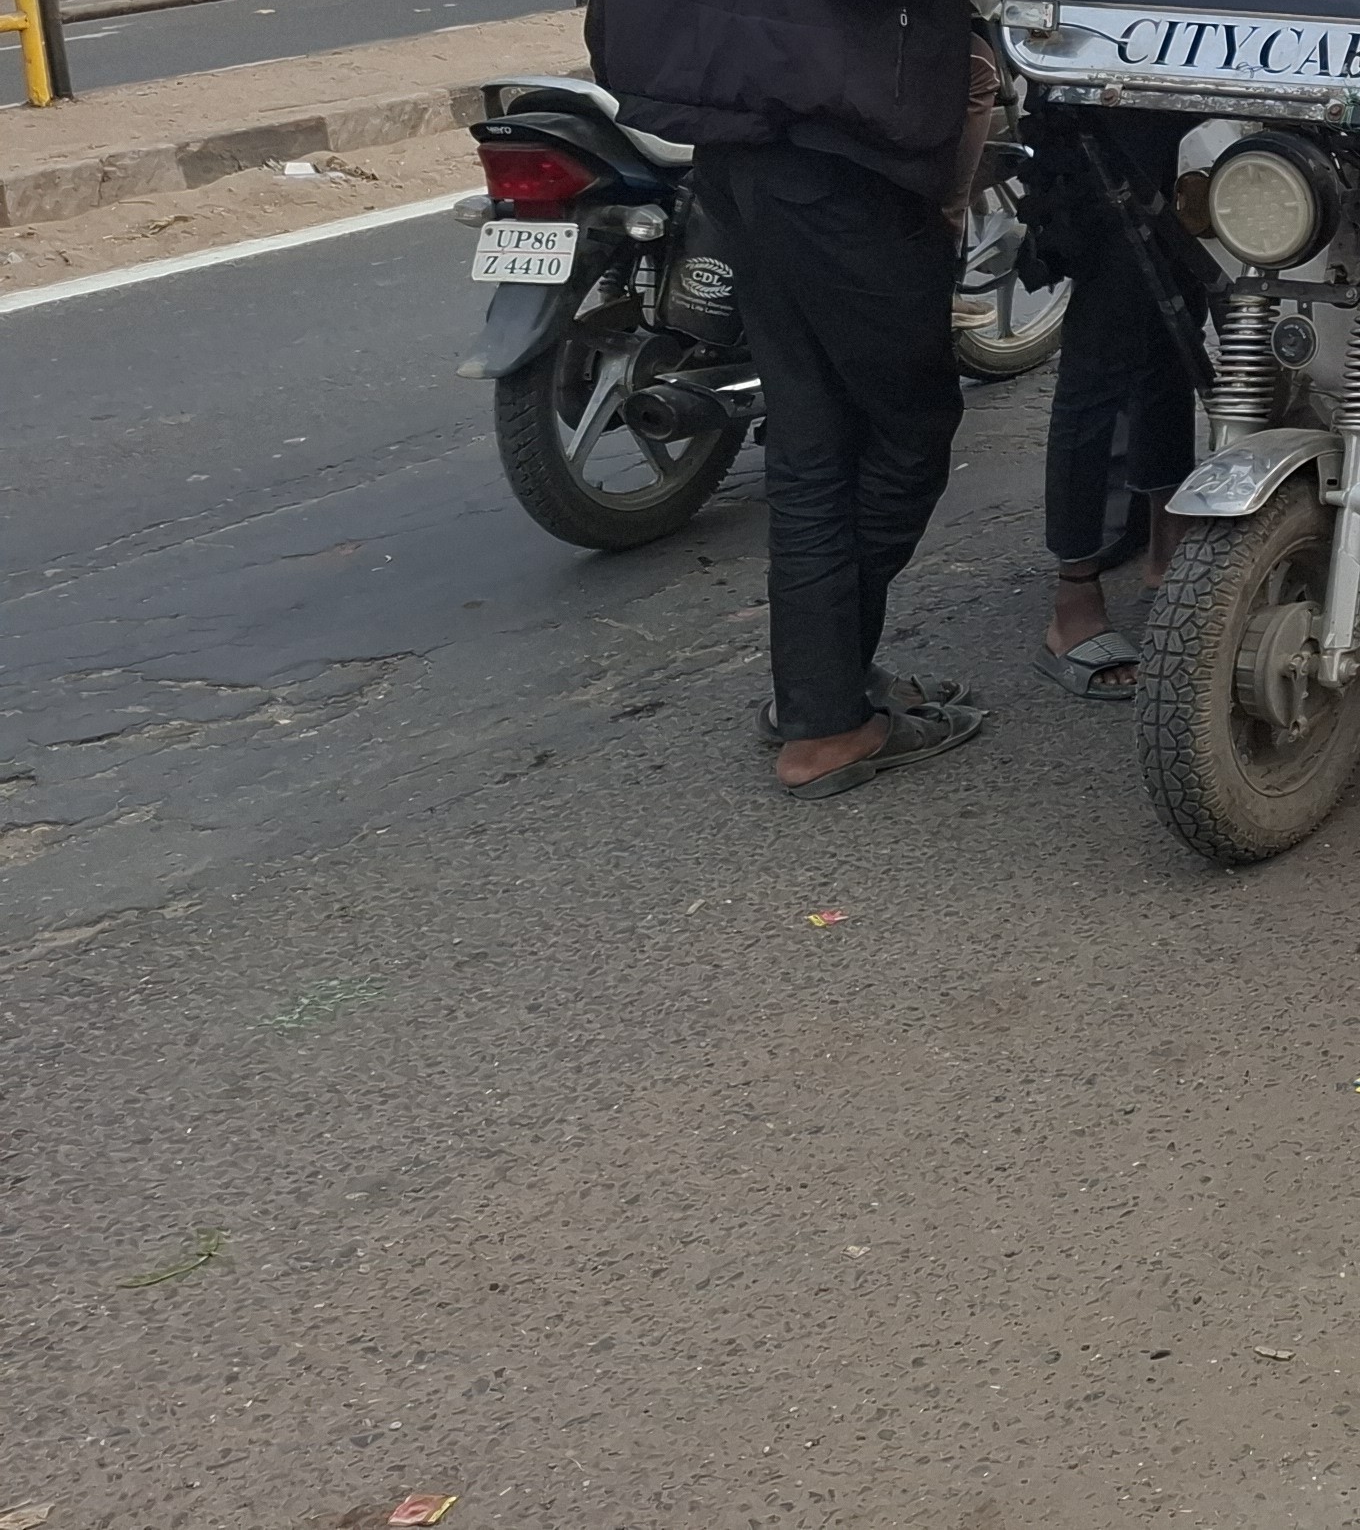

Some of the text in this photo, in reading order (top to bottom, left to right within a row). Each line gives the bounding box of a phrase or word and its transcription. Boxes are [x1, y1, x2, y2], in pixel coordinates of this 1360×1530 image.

[496, 229, 558, 250] UP86
[483, 255, 561, 276] Z 4410
[692, 270, 722, 286] CDL
